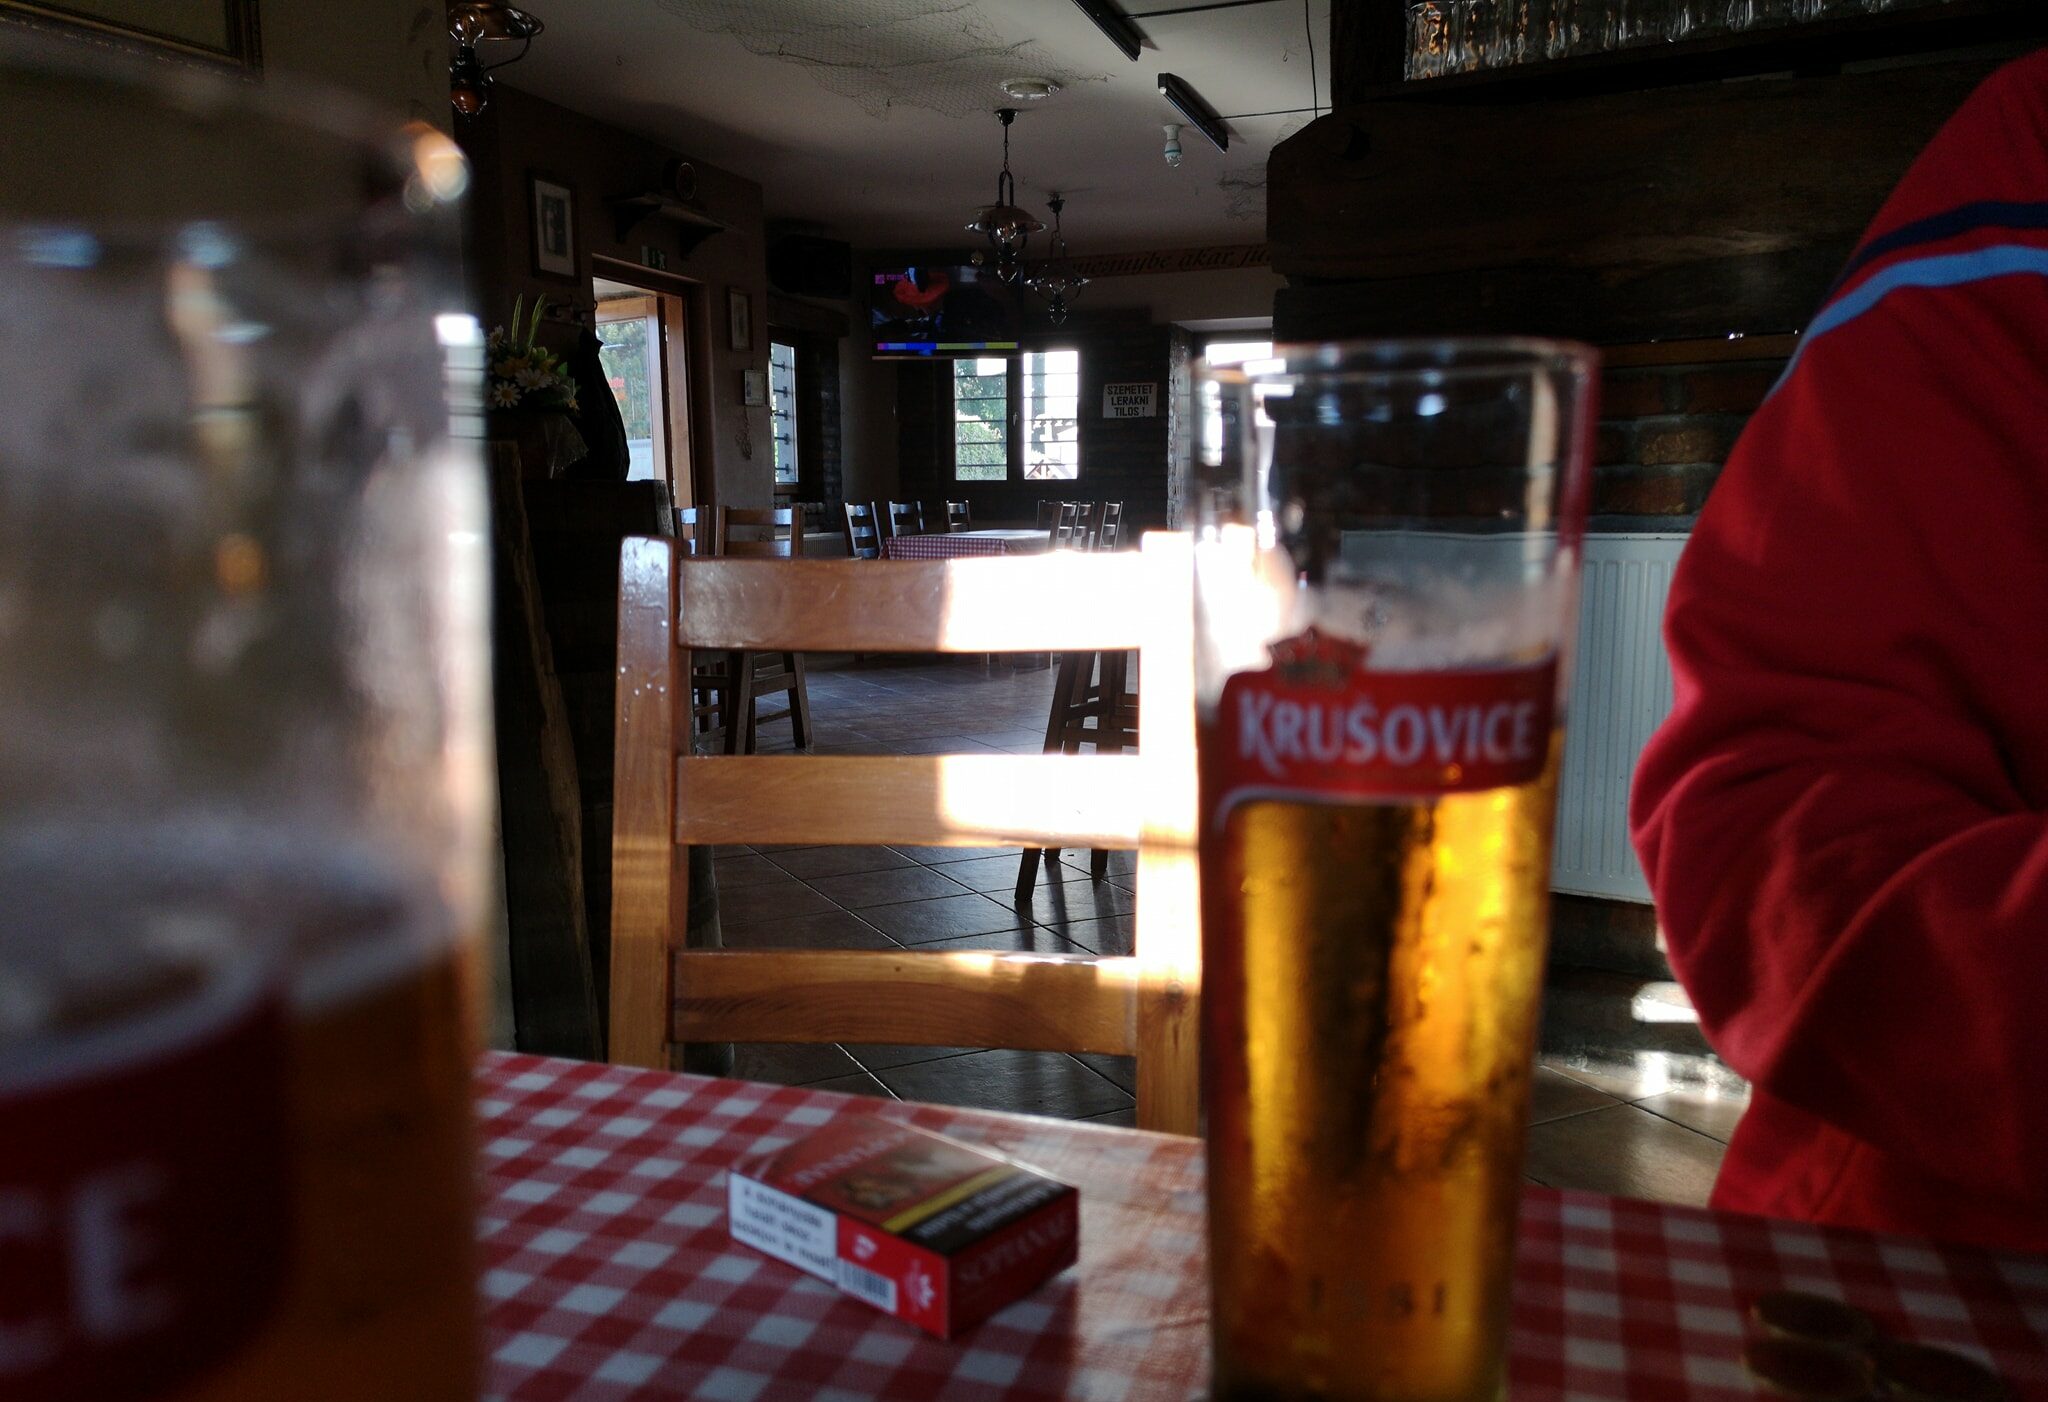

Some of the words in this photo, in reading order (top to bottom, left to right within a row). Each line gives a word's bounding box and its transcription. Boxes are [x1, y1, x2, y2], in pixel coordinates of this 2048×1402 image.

[1178, 248, 1235, 271] akar
[1107, 384, 1153, 395] SZEMETET
[1111, 396, 1149, 406] LERAKNI
[1114, 407, 1139, 417] TILOS
